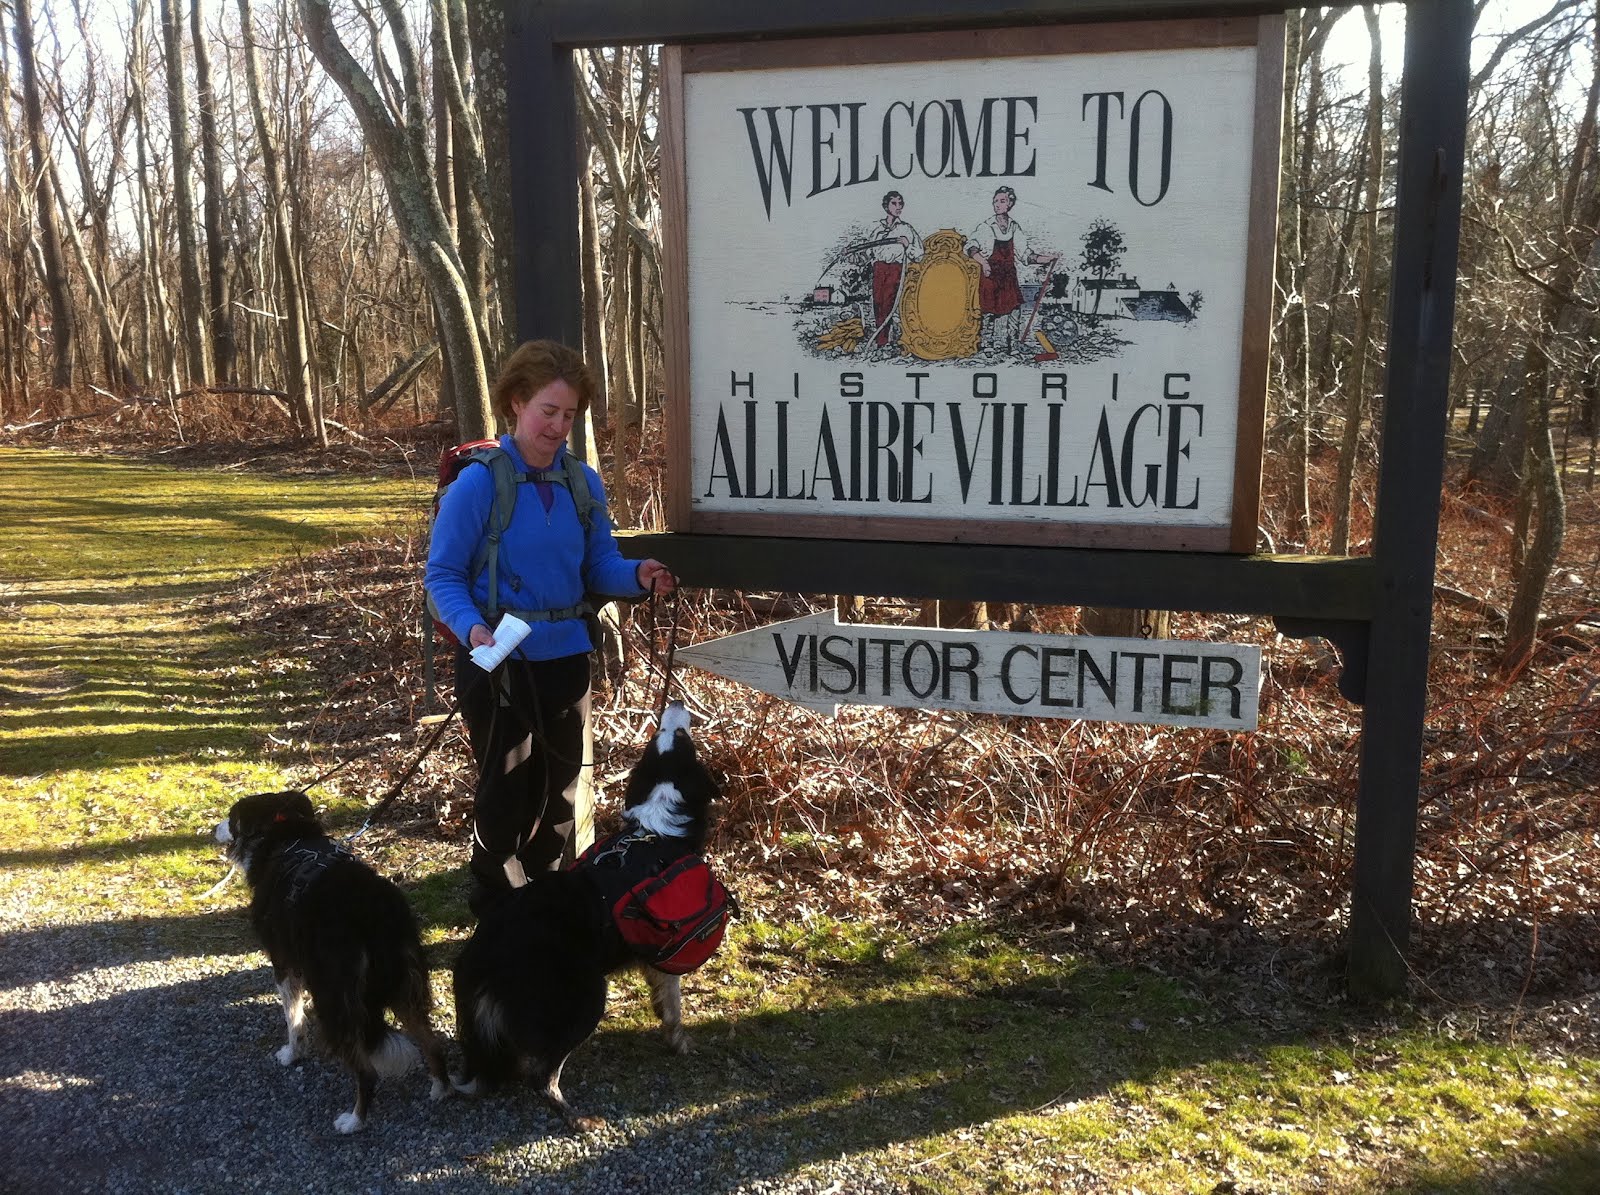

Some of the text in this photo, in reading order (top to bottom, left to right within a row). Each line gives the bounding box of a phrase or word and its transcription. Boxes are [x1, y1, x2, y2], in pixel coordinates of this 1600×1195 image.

[736, 89, 1173, 222] WELCOME TO
[731, 370, 1190, 400] HISTORIC
[704, 400, 1204, 510] ALLAIRE VILLAGE
[772, 632, 1244, 720] VISITOR CENTER
